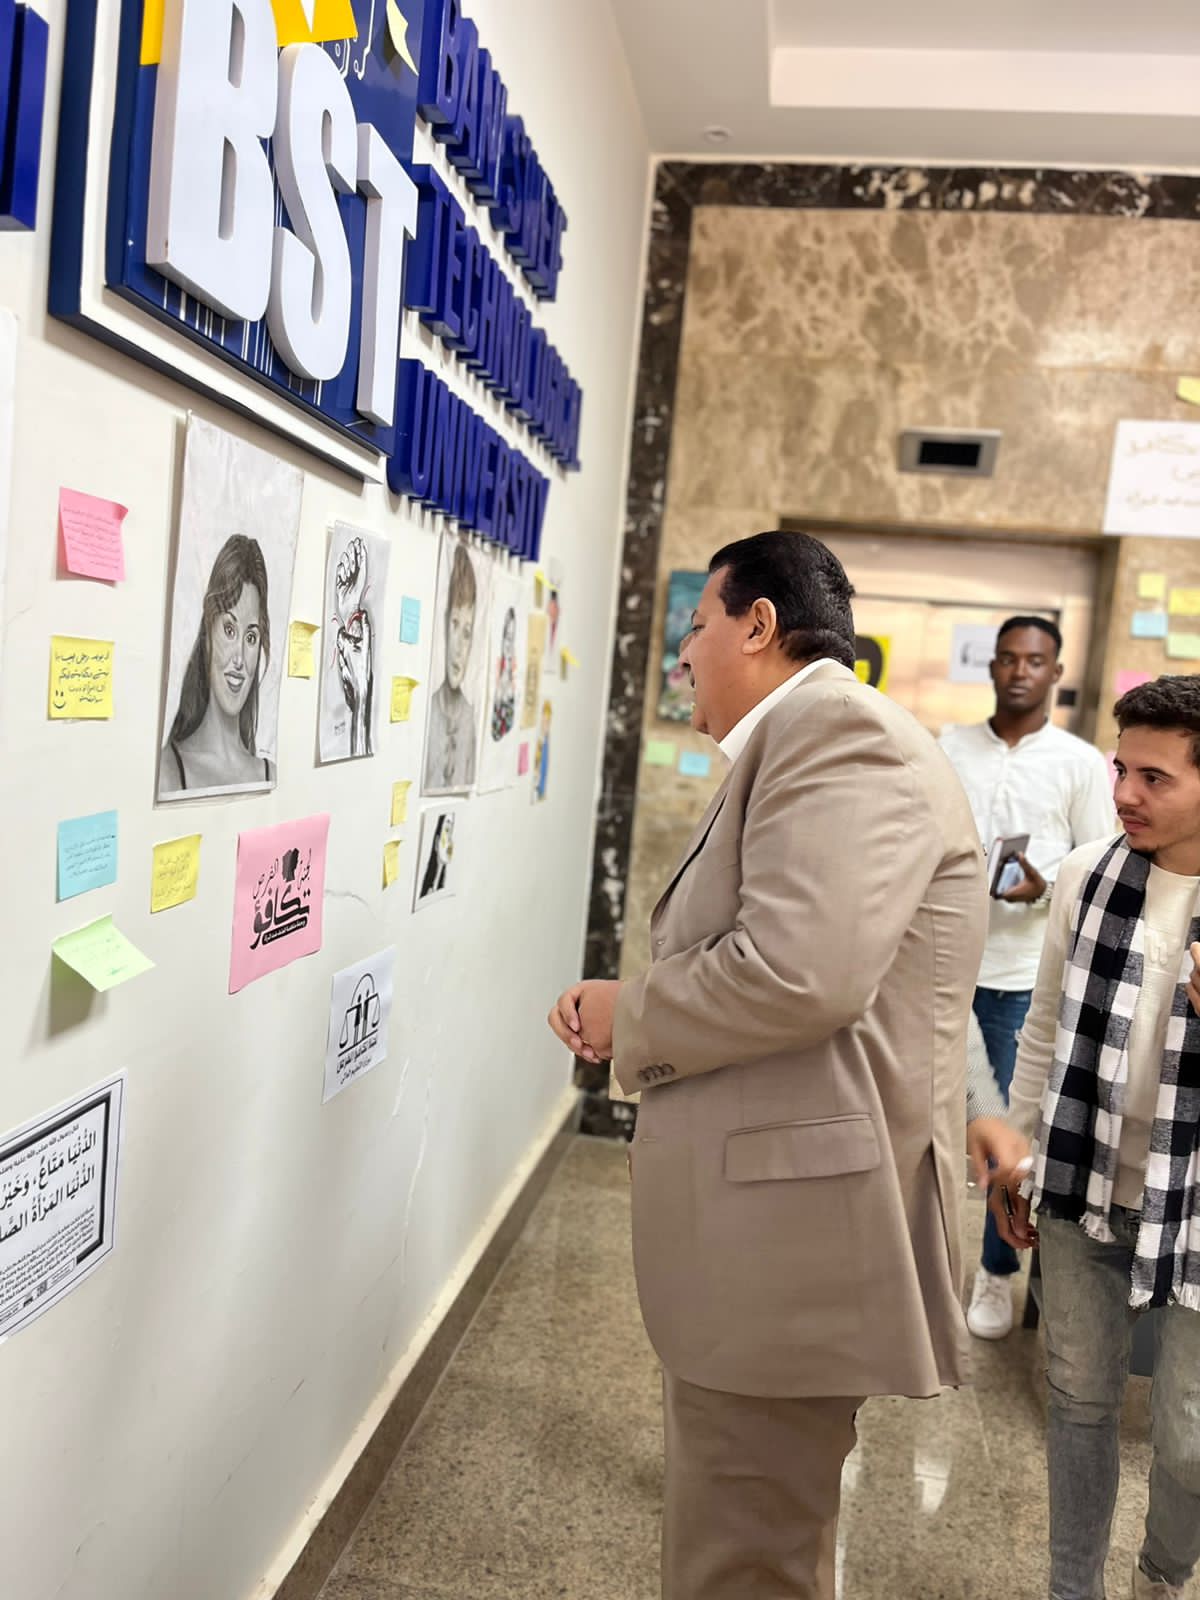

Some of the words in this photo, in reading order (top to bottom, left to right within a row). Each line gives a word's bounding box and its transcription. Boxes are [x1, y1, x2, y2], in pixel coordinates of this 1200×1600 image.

[147, 0, 419, 427] BST
[386, 357, 551, 563] UNIVERSITY
[250, 883, 311, 950] تكافؤ
